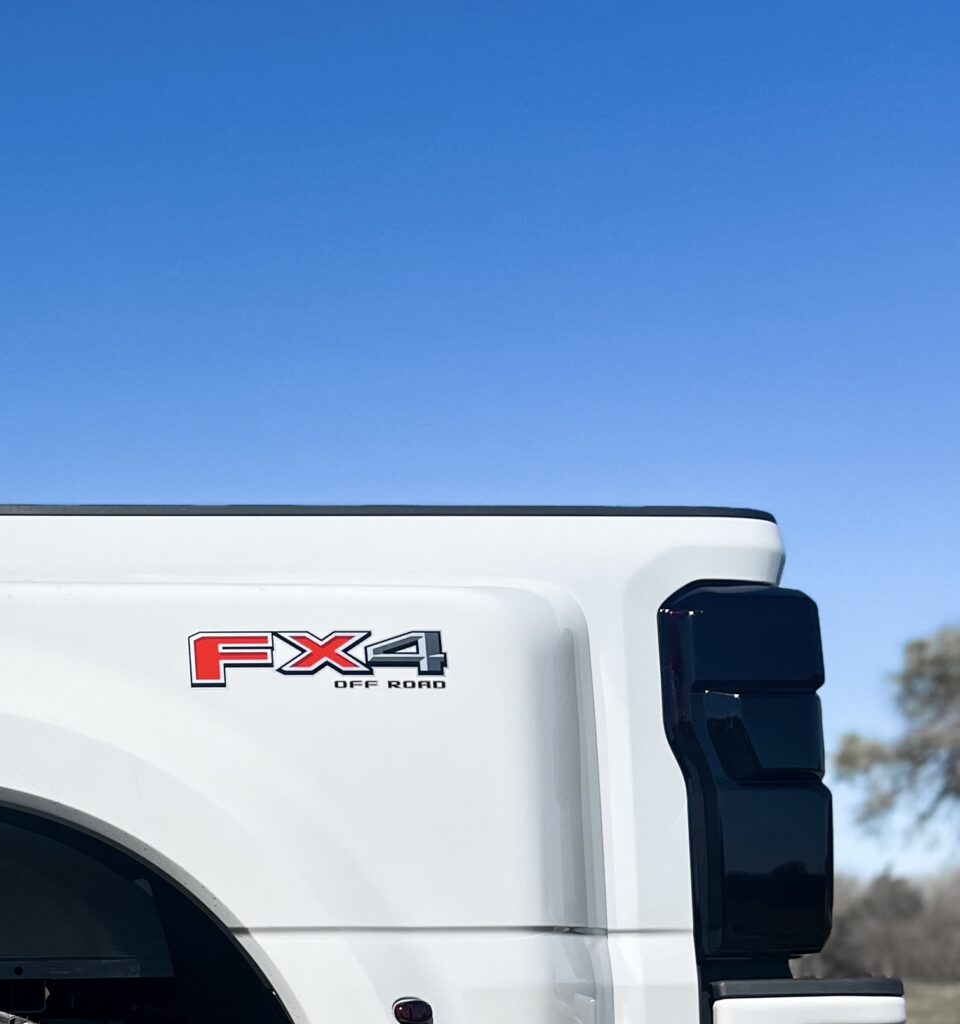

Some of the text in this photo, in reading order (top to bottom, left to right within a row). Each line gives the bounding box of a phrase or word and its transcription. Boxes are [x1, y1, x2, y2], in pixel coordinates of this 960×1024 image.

[188, 630, 448, 688] FX4
[334, 680, 446, 689] OFF ROAD
